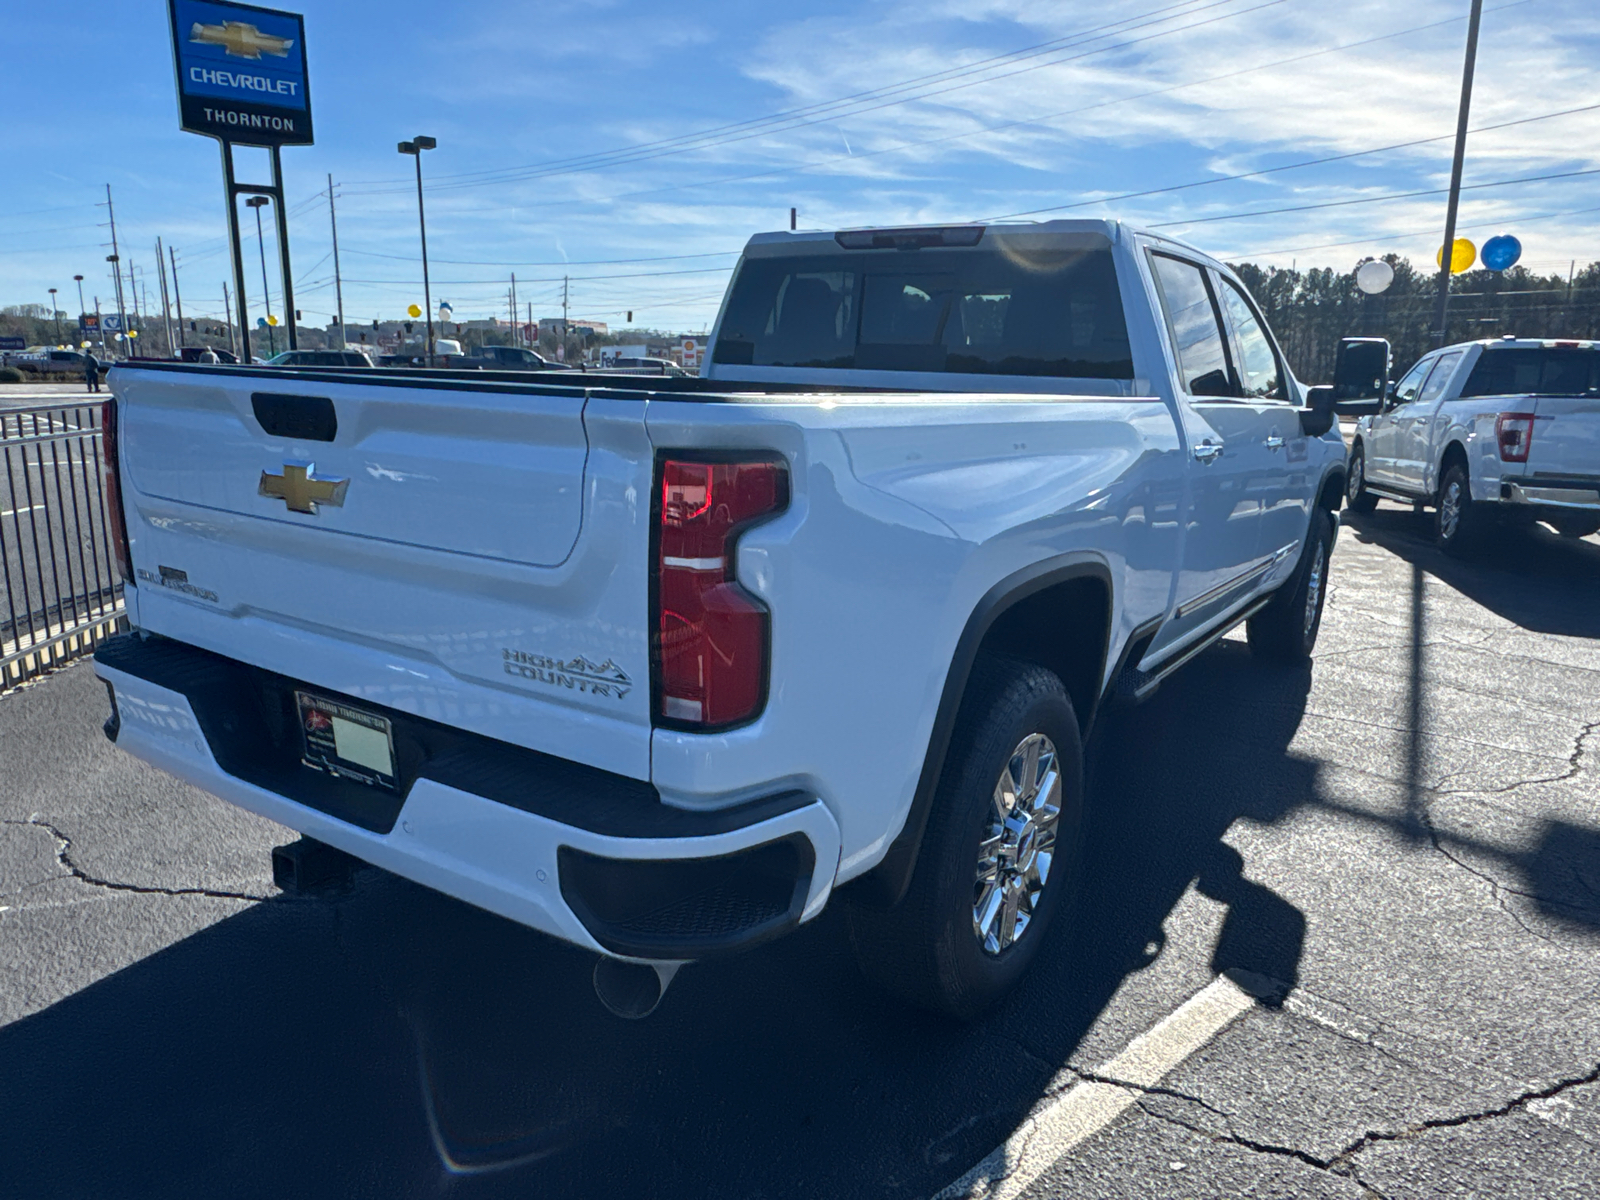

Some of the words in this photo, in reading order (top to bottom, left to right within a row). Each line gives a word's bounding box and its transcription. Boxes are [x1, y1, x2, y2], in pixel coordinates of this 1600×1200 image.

[190, 67, 298, 96] CHEVROLET
[203, 107, 294, 132] THORNTON
[602, 351, 622, 368] Fed
[502, 648, 564, 672] HIGH
[503, 661, 631, 699] COUNTRY
